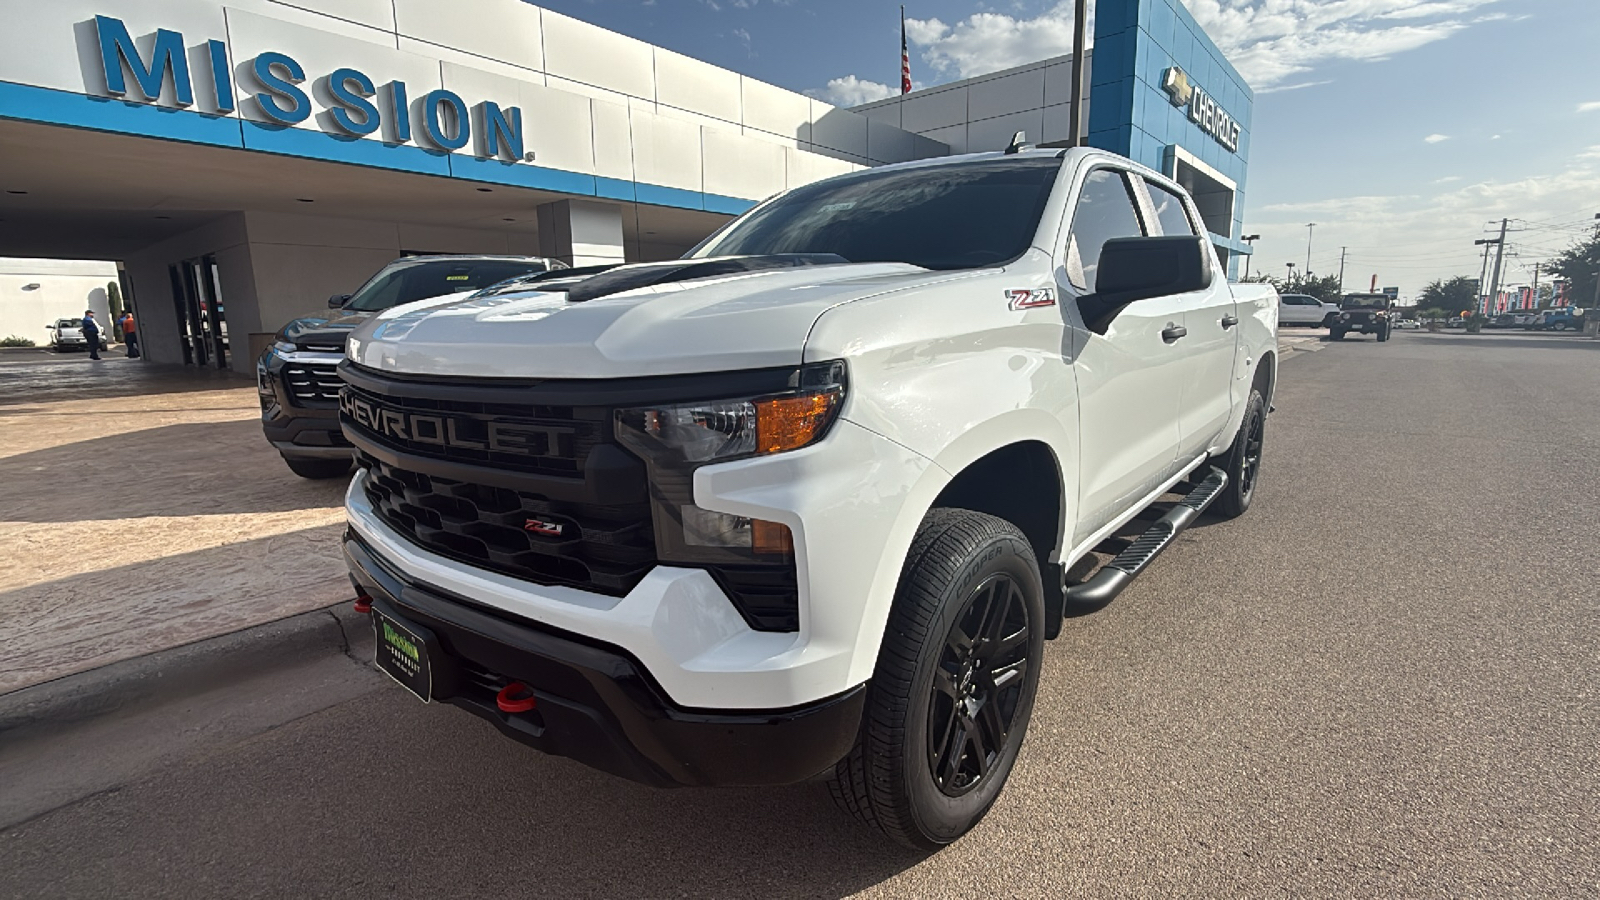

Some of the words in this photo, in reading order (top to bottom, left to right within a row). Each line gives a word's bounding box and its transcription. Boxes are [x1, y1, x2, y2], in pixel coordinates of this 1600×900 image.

[94, 14, 525, 162] MISSION
[1192, 85, 1242, 154] CHEVROLET
[1004, 288, 1055, 311] Z71
[339, 393, 575, 456] CHEVROLET
[525, 518, 562, 535] Z71
[956, 546, 1003, 600] COOPER
